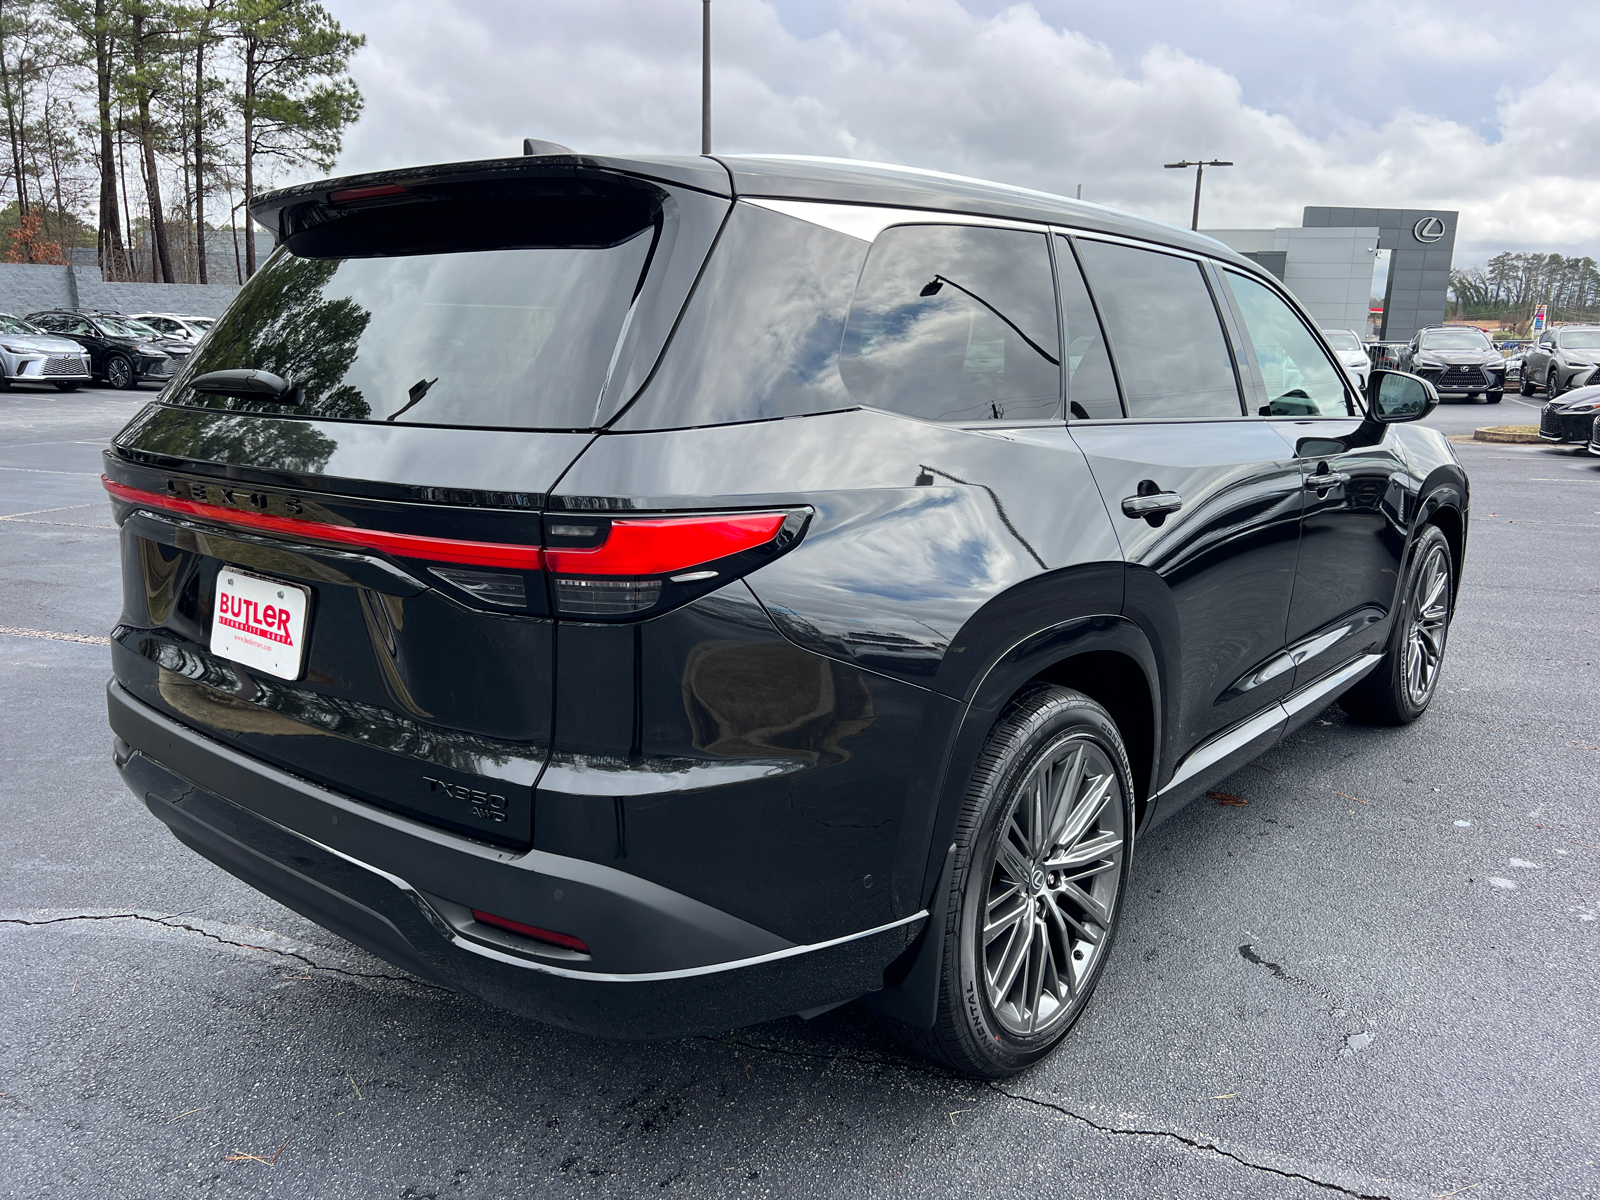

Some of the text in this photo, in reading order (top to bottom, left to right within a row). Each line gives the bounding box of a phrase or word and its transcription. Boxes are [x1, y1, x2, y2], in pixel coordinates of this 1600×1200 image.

[166, 479, 303, 514] LEXUS
[219, 616, 291, 645] AUTOMOTIVE GROUP
[422, 775, 509, 810] TX350
[469, 806, 508, 823] AWD
